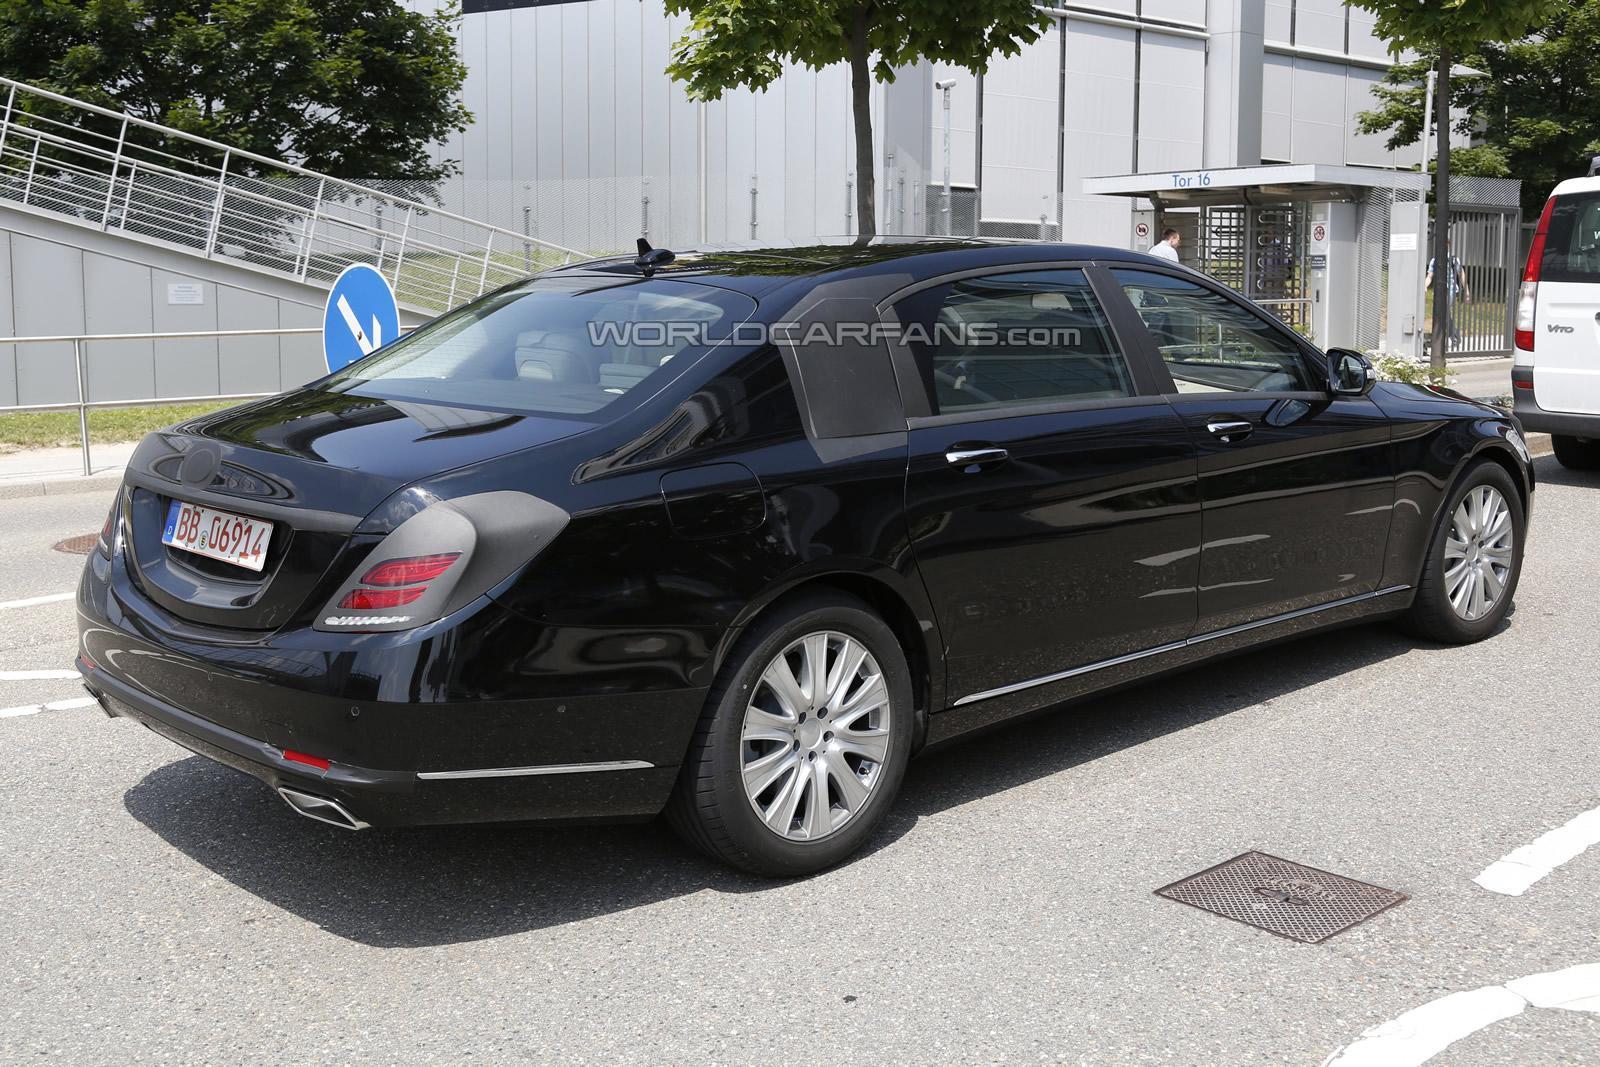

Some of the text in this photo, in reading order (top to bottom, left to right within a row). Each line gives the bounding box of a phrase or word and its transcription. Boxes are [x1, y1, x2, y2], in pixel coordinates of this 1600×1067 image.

[1172, 172, 1211, 187] Tor 16
[176, 507, 266, 562] BB 06914
